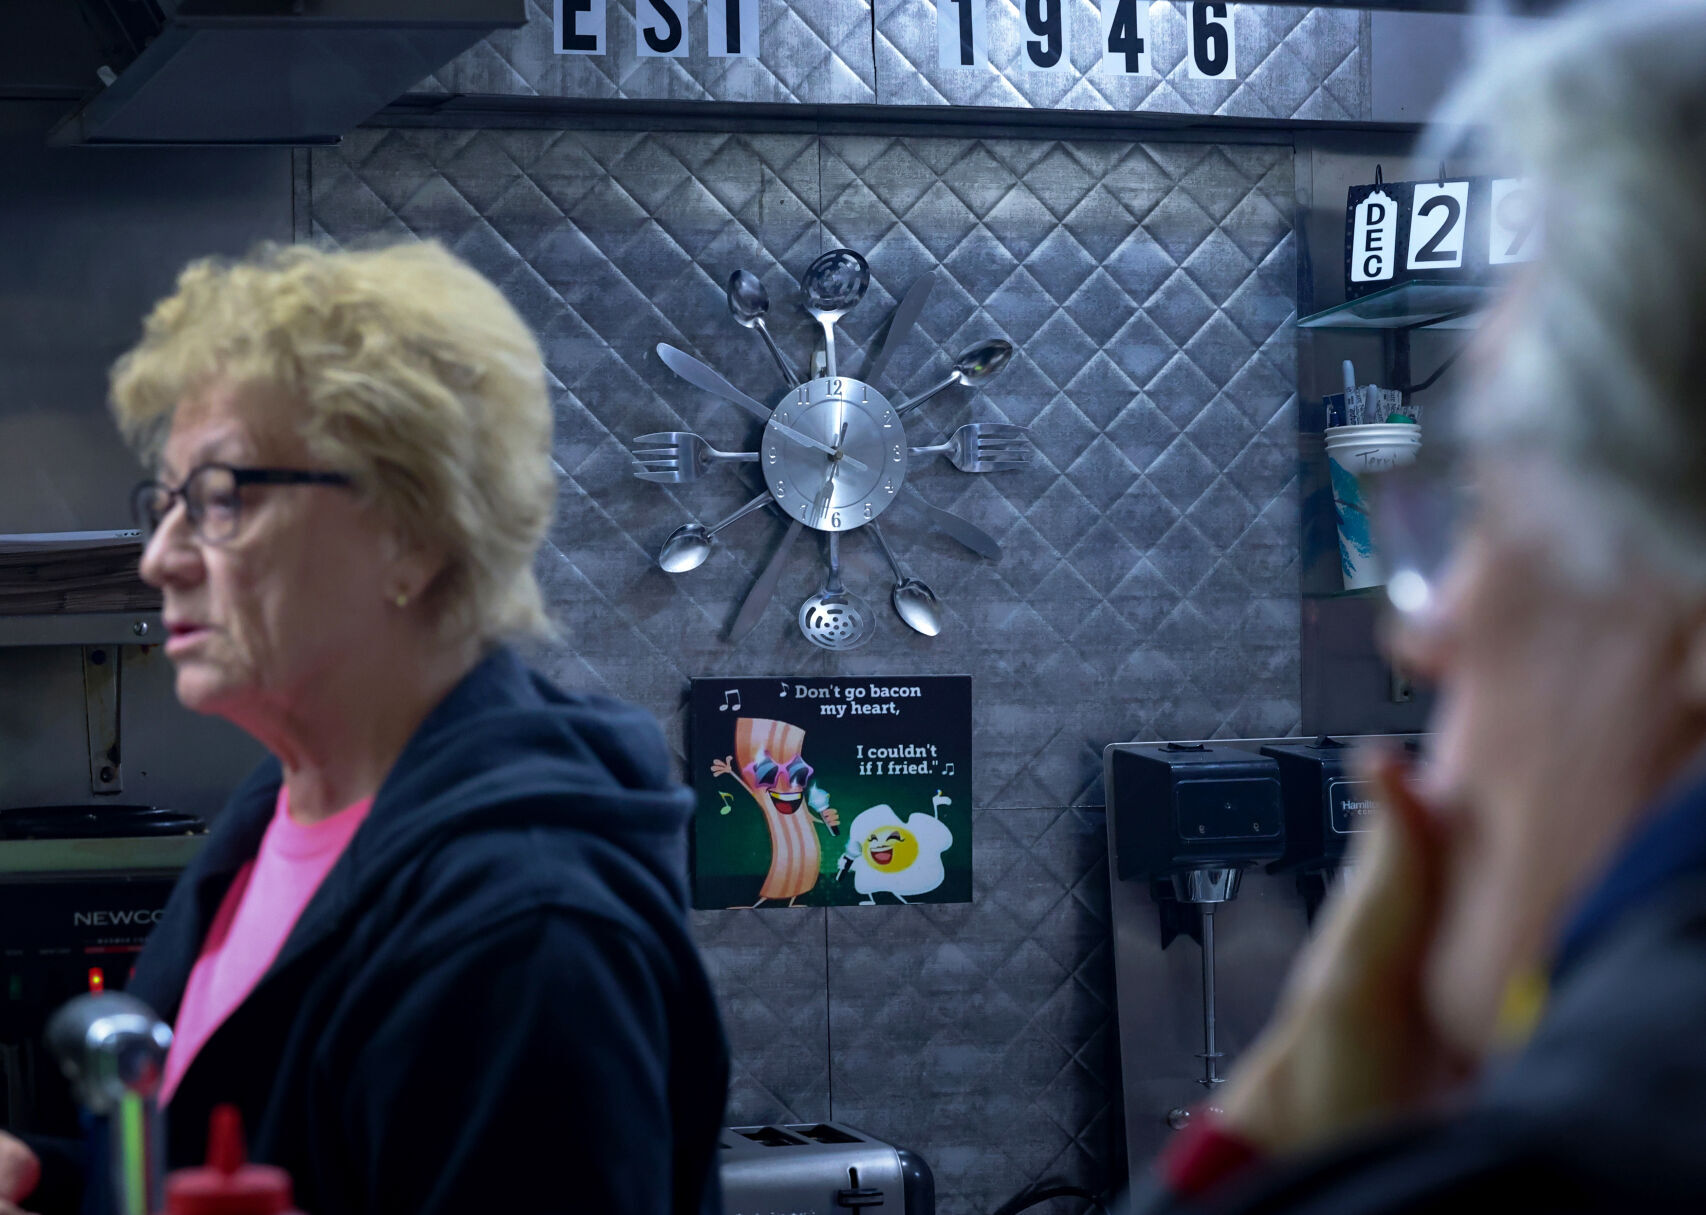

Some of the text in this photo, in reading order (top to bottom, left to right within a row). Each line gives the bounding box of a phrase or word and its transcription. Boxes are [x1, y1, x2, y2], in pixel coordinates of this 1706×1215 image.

[950, 0, 1229, 77] 1946
[1363, 202, 1386, 278] DEC
[797, 388, 811, 405] 11
[825, 379, 843, 398] 12
[863, 502, 873, 520] 5
[831, 512, 841, 529] 6
[794, 684, 922, 702] Don't go bacon
[820, 701, 901, 718] my heart,
[856, 743, 937, 759] I couldn't
[859, 760, 939, 776] if I fried."
